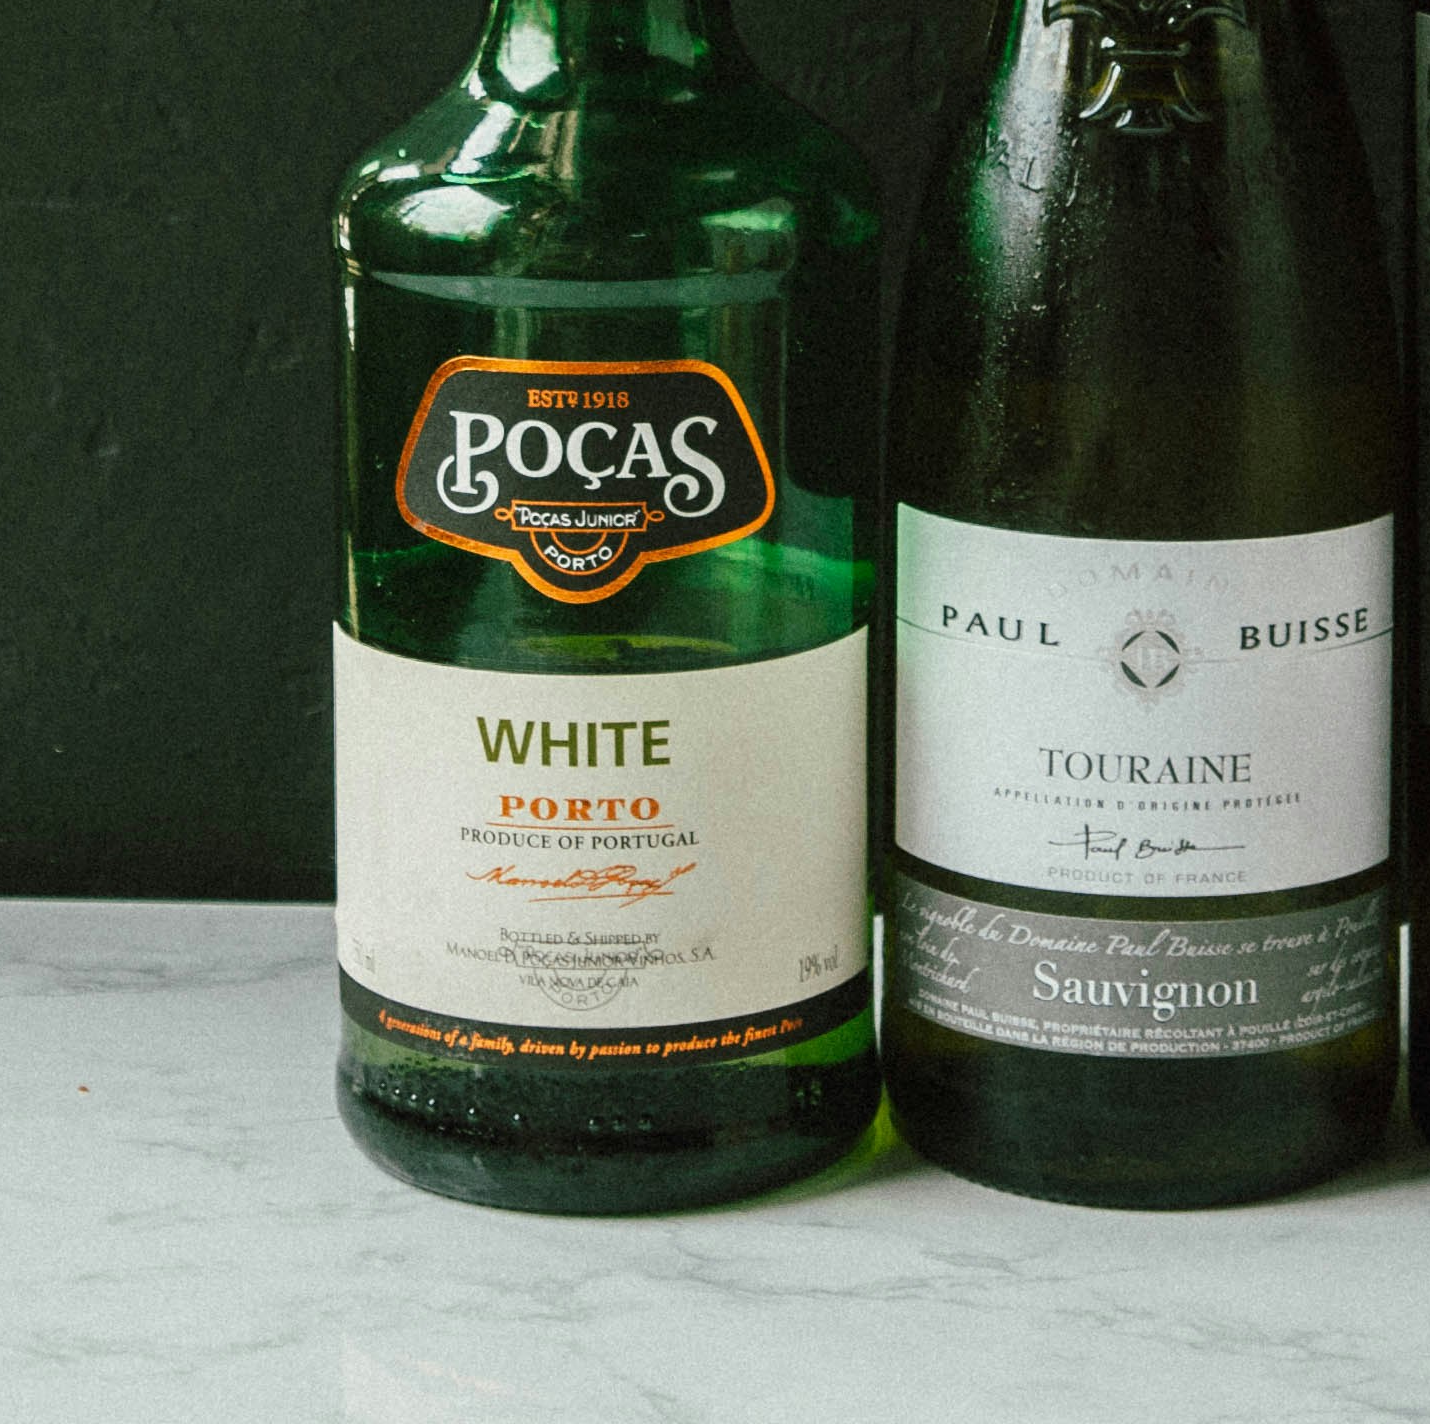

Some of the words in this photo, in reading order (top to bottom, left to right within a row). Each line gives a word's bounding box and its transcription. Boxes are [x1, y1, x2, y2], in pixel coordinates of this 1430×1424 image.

[583, 390, 630, 409] 1918
[543, 545, 613, 571] PORTO
[941, 604, 1061, 647] PAUL
[1240, 607, 1370, 651] BUISSE
[476, 715, 672, 768] WHITE
[1039, 747, 1253, 785] TOURAINE
[497, 794, 662, 822] PORTO
[993, 786, 1105, 810] APPELLATION
[459, 826, 553, 849] PRODUCE
[557, 833, 586, 850] OF
[590, 830, 701, 850] PORTUGAL
[1047, 867, 1134, 885] PRODUCT
[1143, 869, 1167, 885] OF
[1174, 868, 1249, 885] FRANCE
[1008, 926, 1100, 955] Domaine
[1105, 928, 1168, 959] Paul
[1167, 933, 1233, 958] Buisse
[1032, 960, 1260, 1022] Sauvignon
[443, 1029, 459, 1048] of
[459, 1035, 468, 1046] a
[519, 1038, 566, 1056] driven
[569, 1038, 585, 1060] by
[588, 1038, 642, 1060] passion
[645, 1039, 660, 1056] to
[662, 1035, 718, 1058] produce
[721, 1029, 742, 1046] the
[741, 1025, 778, 1048] finest
[1108, 1040, 1126, 1054] DE
[1130, 1039, 1221, 1054] PRODUCTION
